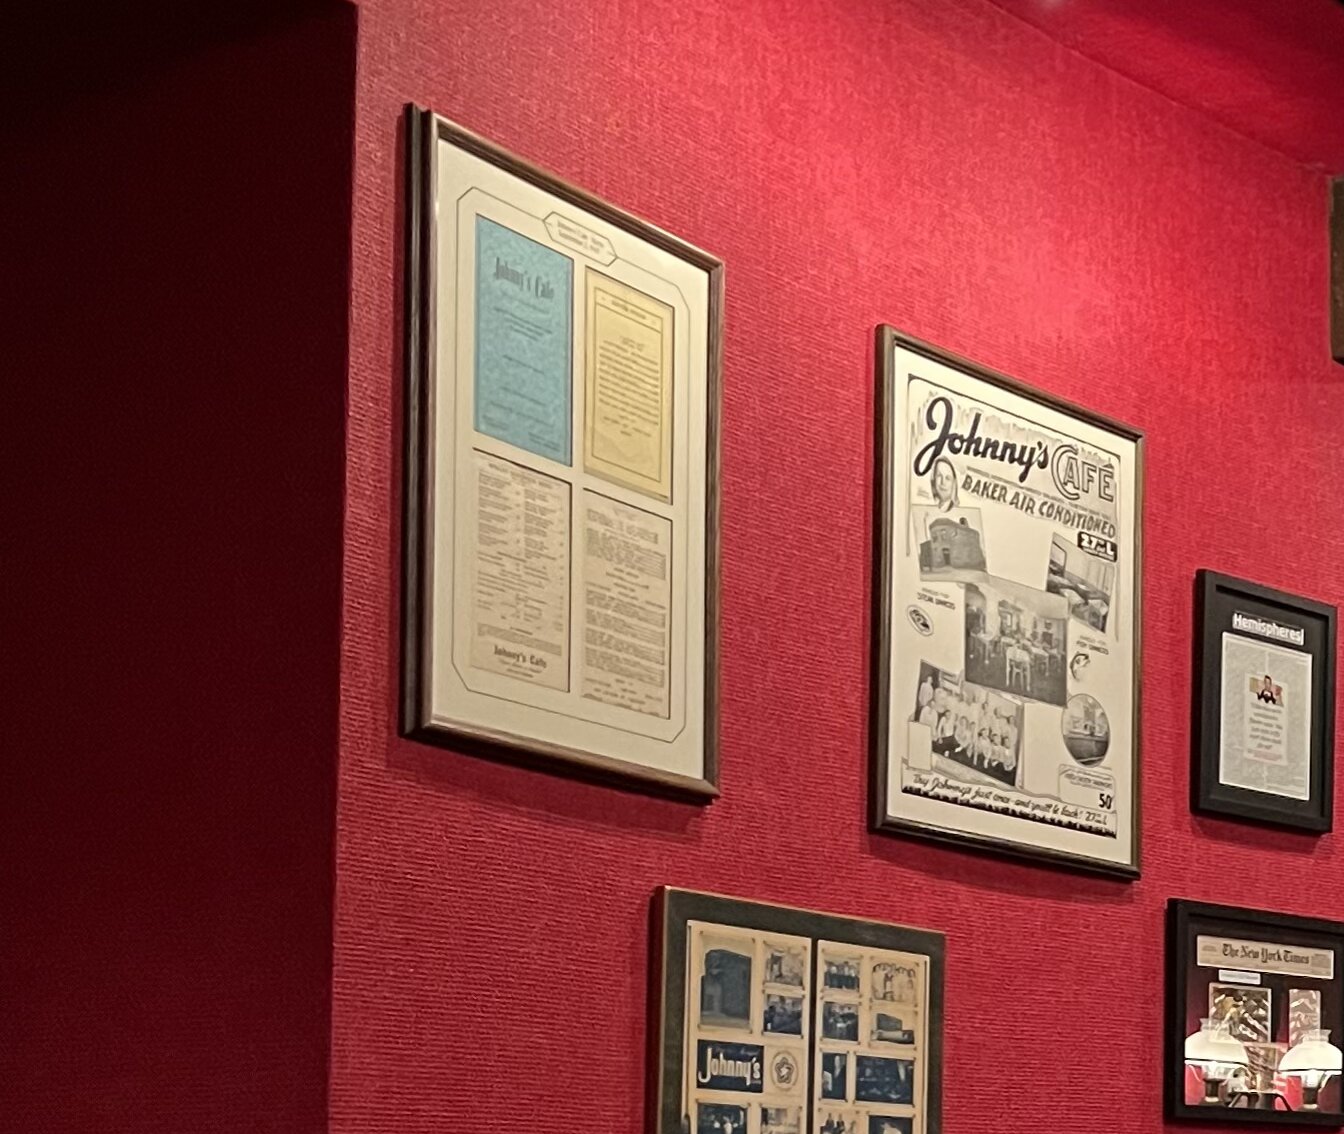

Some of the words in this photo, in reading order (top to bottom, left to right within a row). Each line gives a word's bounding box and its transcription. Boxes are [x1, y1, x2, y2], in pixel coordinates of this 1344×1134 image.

[913, 396, 1049, 483] Johnny's
[961, 474, 1009, 504] BAKER
[1009, 490, 1036, 515] AIR
[1038, 500, 1117, 540] CONDITIONED
[1233, 613, 1301, 642] Hemispheres
[1222, 943, 1239, 958] The
[1240, 945, 1259, 959] New
[1261, 947, 1282, 963] York
[1283, 950, 1310, 965] Times
[698, 1046, 762, 1087] Johnny's
